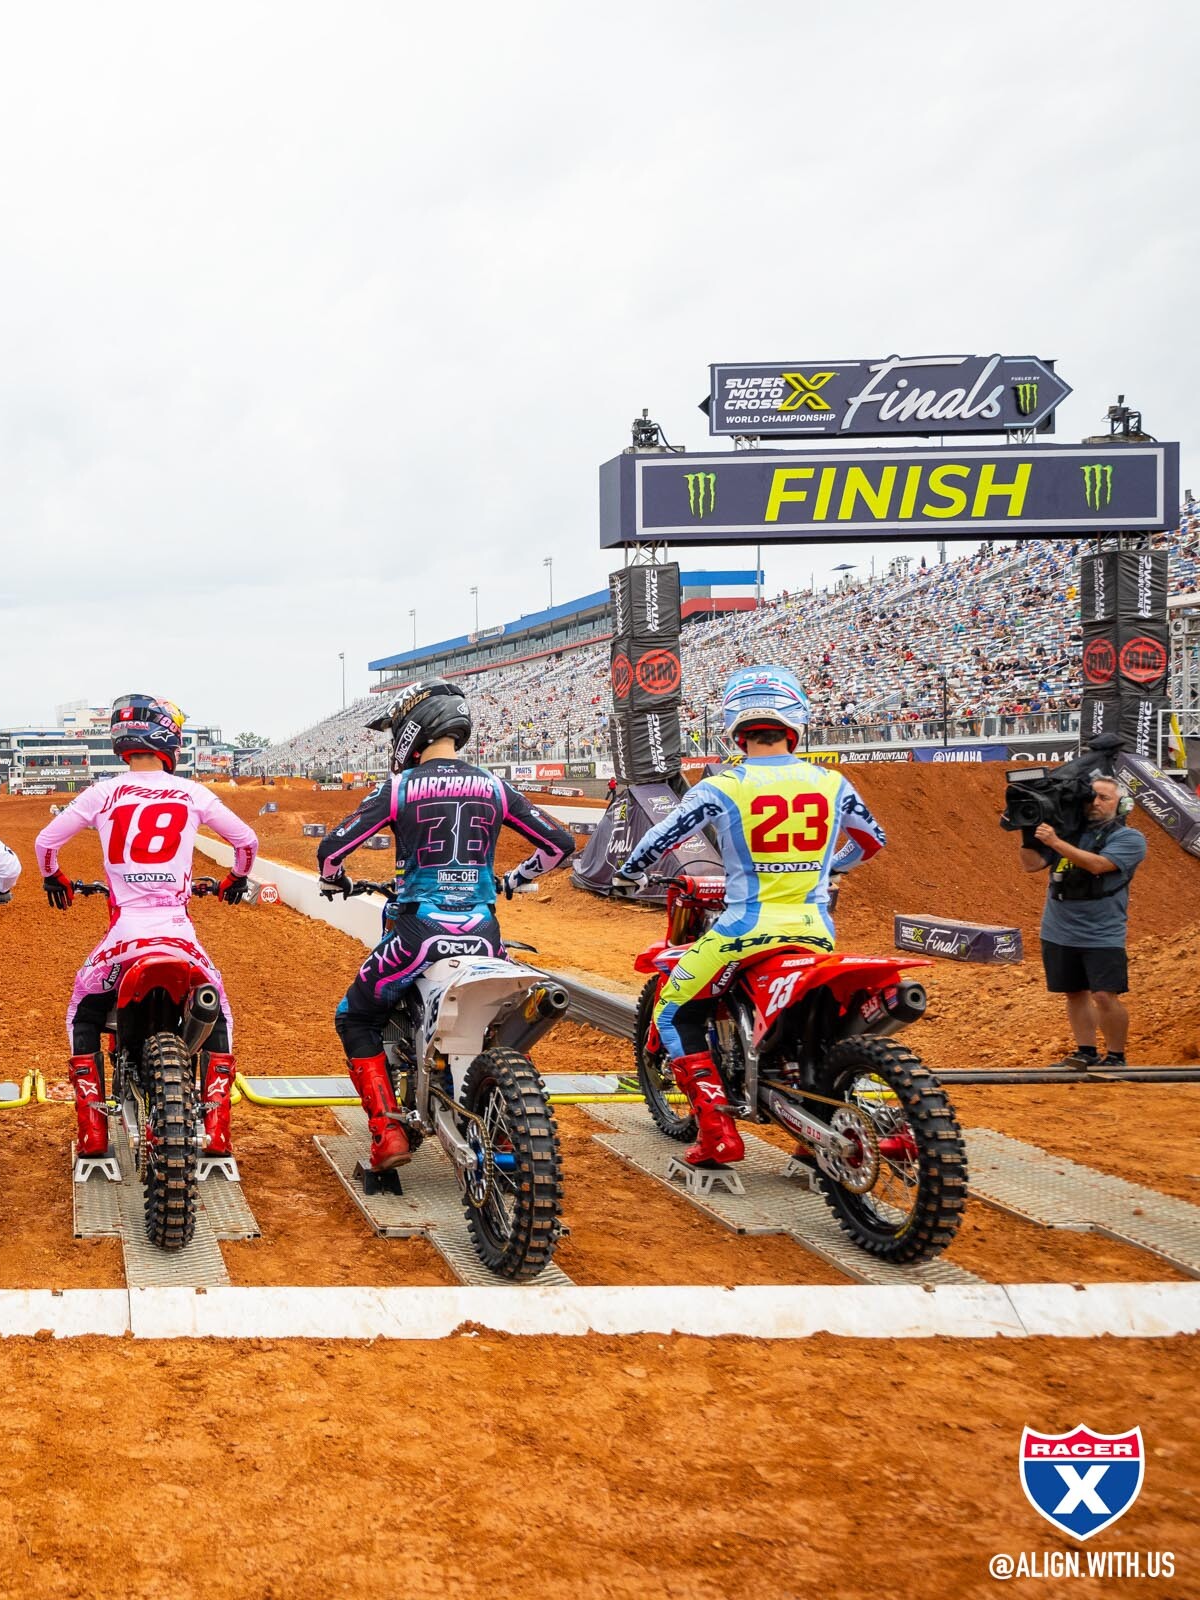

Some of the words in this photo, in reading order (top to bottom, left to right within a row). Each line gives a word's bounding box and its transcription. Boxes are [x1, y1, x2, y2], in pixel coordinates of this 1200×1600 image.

[724, 377, 785, 388] SUPER
[841, 354, 1004, 430] Finals
[729, 388, 782, 399] MOTO
[724, 399, 784, 410] CROSS
[726, 416, 759, 424] WORLD
[761, 413, 836, 423] CHAMPIONSHIP
[764, 463, 1033, 522] FINISH
[849, 752, 871, 762] ROCKY
[872, 751, 909, 761] MOUNTAIN
[944, 751, 983, 763] YAMAHA
[100, 784, 191, 814] LAWRENCE
[407, 776, 495, 803] MARCHBANKS
[751, 792, 829, 853] 23
[107, 802, 189, 865] 18
[416, 801, 497, 868] 36
[439, 870, 477, 882] Muc-Off
[754, 861, 822, 873] HONDA
[125, 873, 176, 883] HONDA
[925, 928, 960, 955] Finals
[359, 935, 412, 982] FXR
[781, 957, 815, 968] HONDA
[765, 971, 801, 1017] 23
